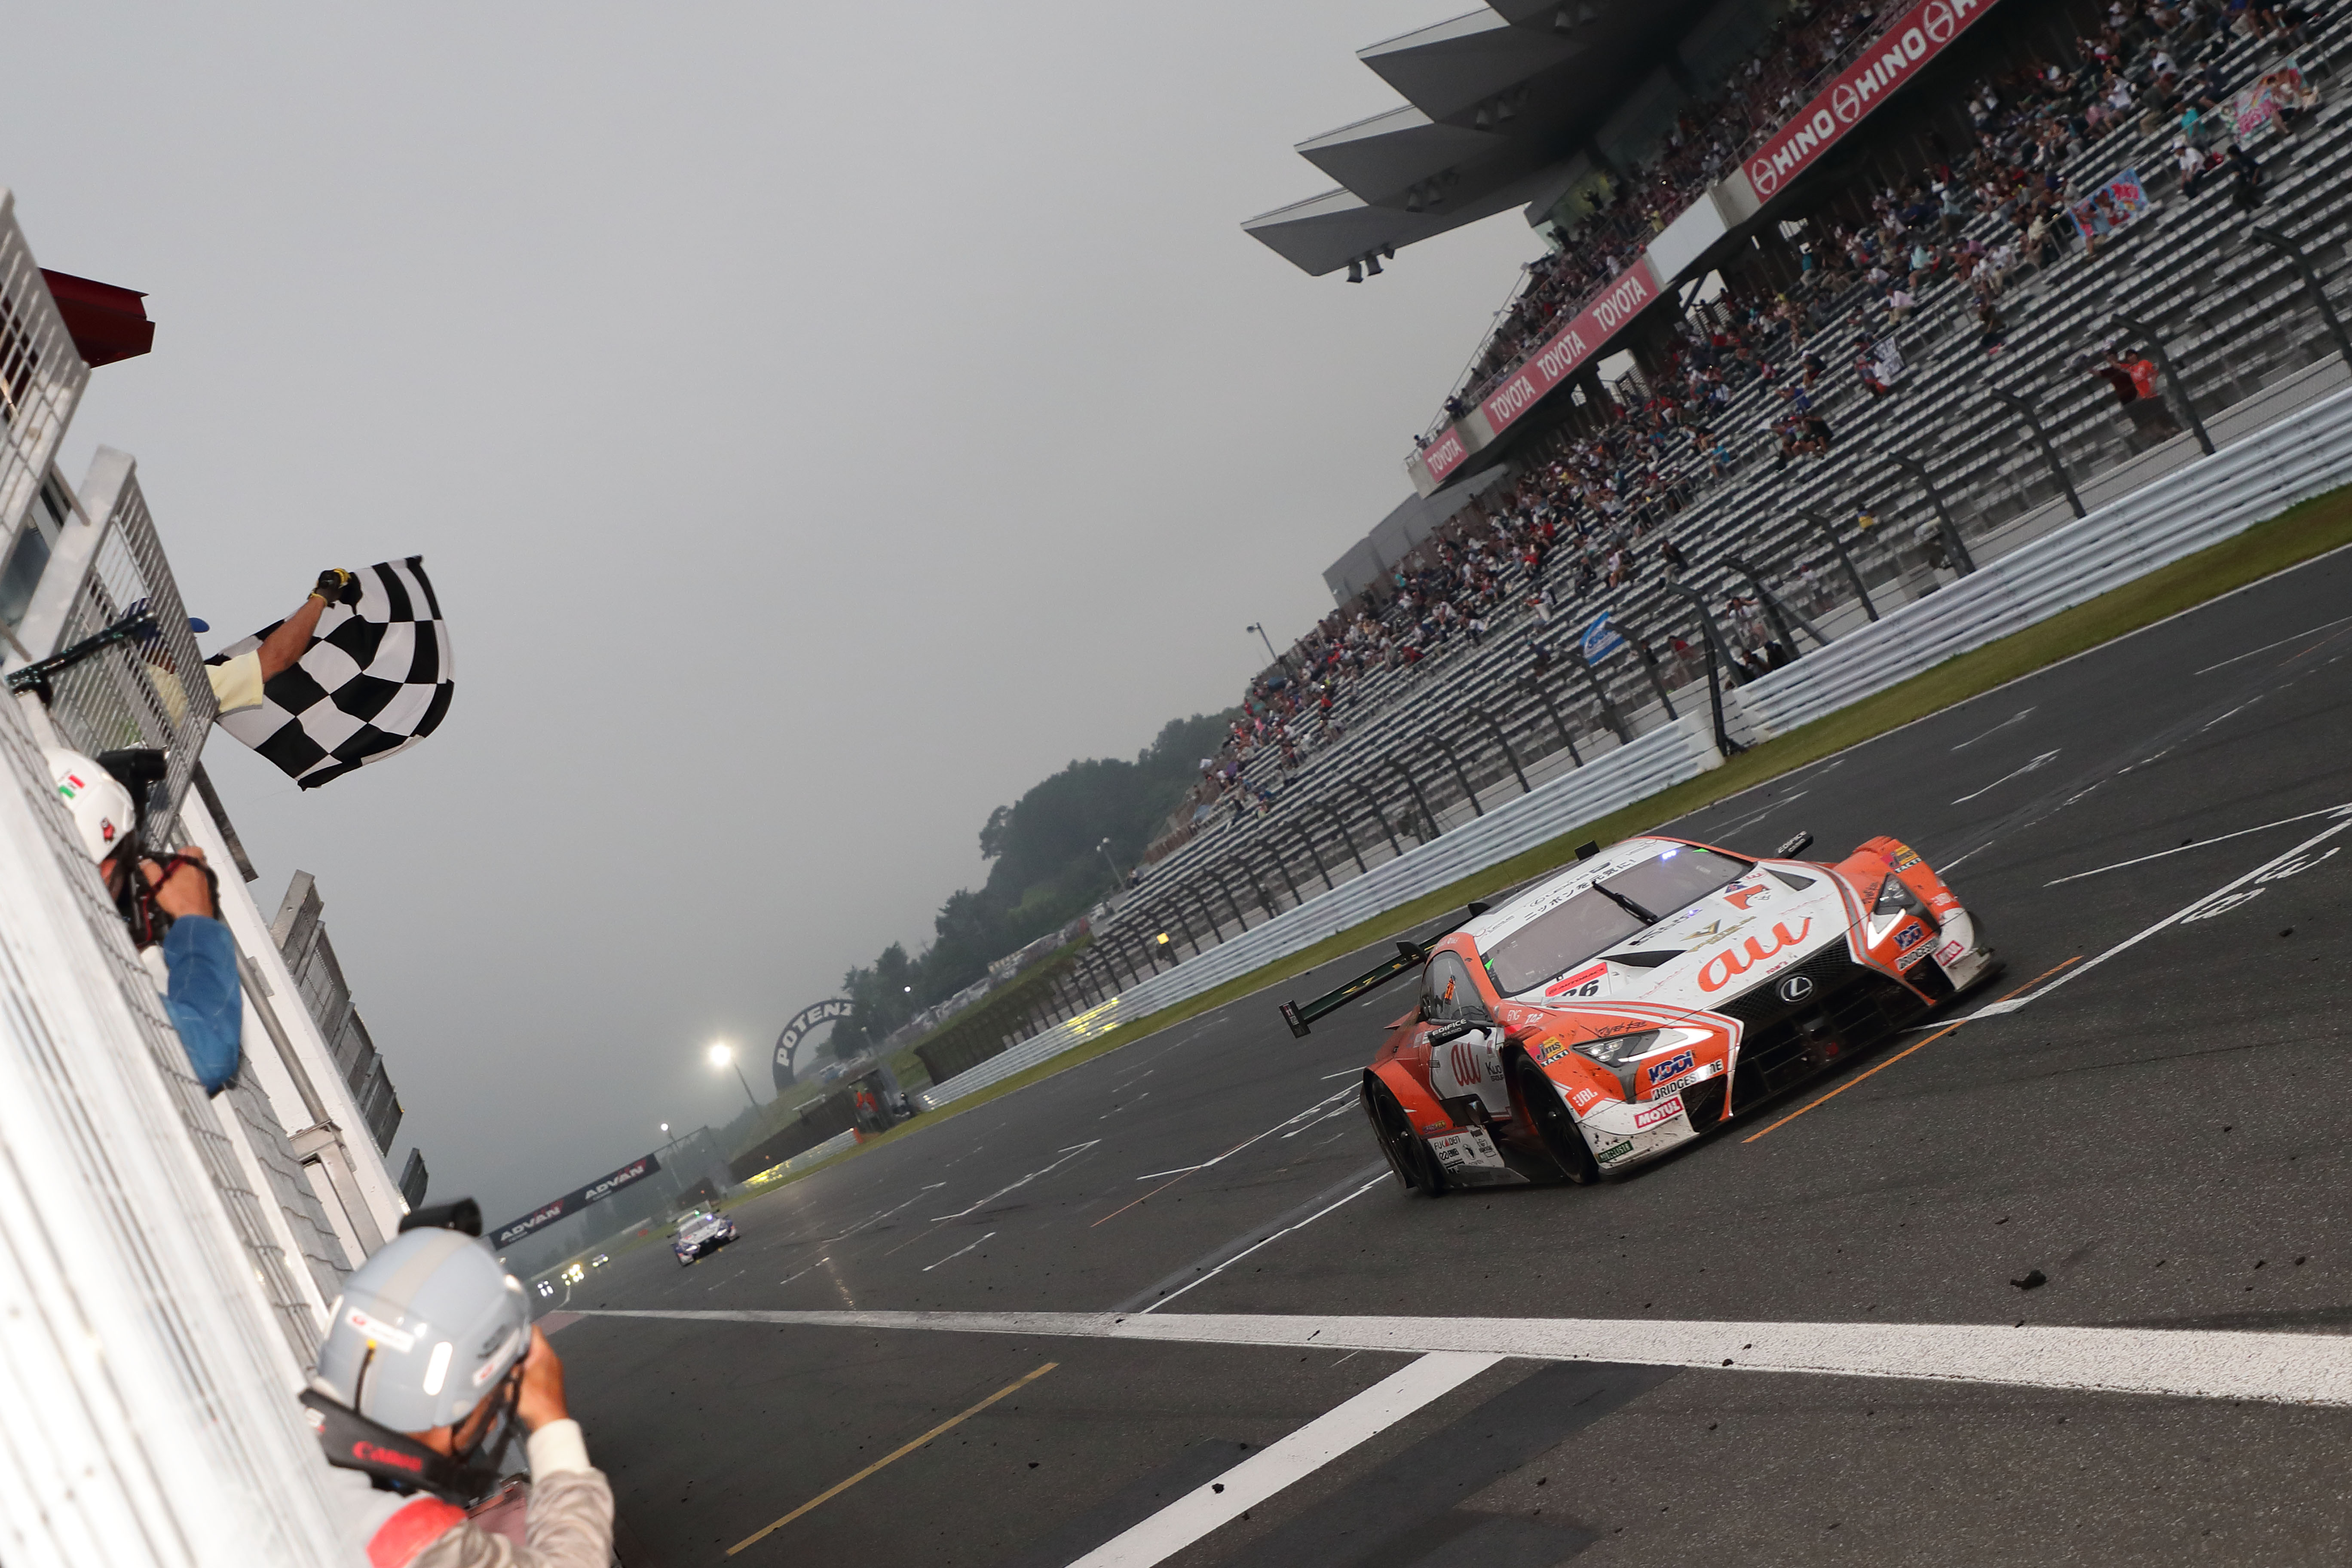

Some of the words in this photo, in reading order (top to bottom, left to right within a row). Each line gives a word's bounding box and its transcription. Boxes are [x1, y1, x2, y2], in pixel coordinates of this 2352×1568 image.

[1856, 26, 1928, 101] HINO
[1771, 110, 1837, 175] HINO
[1592, 276, 1648, 332] TOYOTA
[1537, 331, 1587, 381] TOYOTA
[1490, 376, 1536, 422] TOYOTA
[1427, 437, 1462, 473] TOYOTA
[1698, 917, 1812, 992] au
[776, 1002, 855, 1066] POTENZ
[1432, 1019, 1467, 1036] EDIFICE
[1452, 1042, 1481, 1086] au
[1485, 1062, 1501, 1075] Kuo
[1536, 1042, 1561, 1061] jms
[1542, 1050, 1569, 1066] TACTI
[1648, 1050, 1695, 1084] KDDI
[1573, 1088, 1598, 1107] JBL
[1638, 1101, 1681, 1126] MOTUL
[585, 1165, 643, 1200] ADVAN
[500, 1206, 561, 1241] ADVAN
